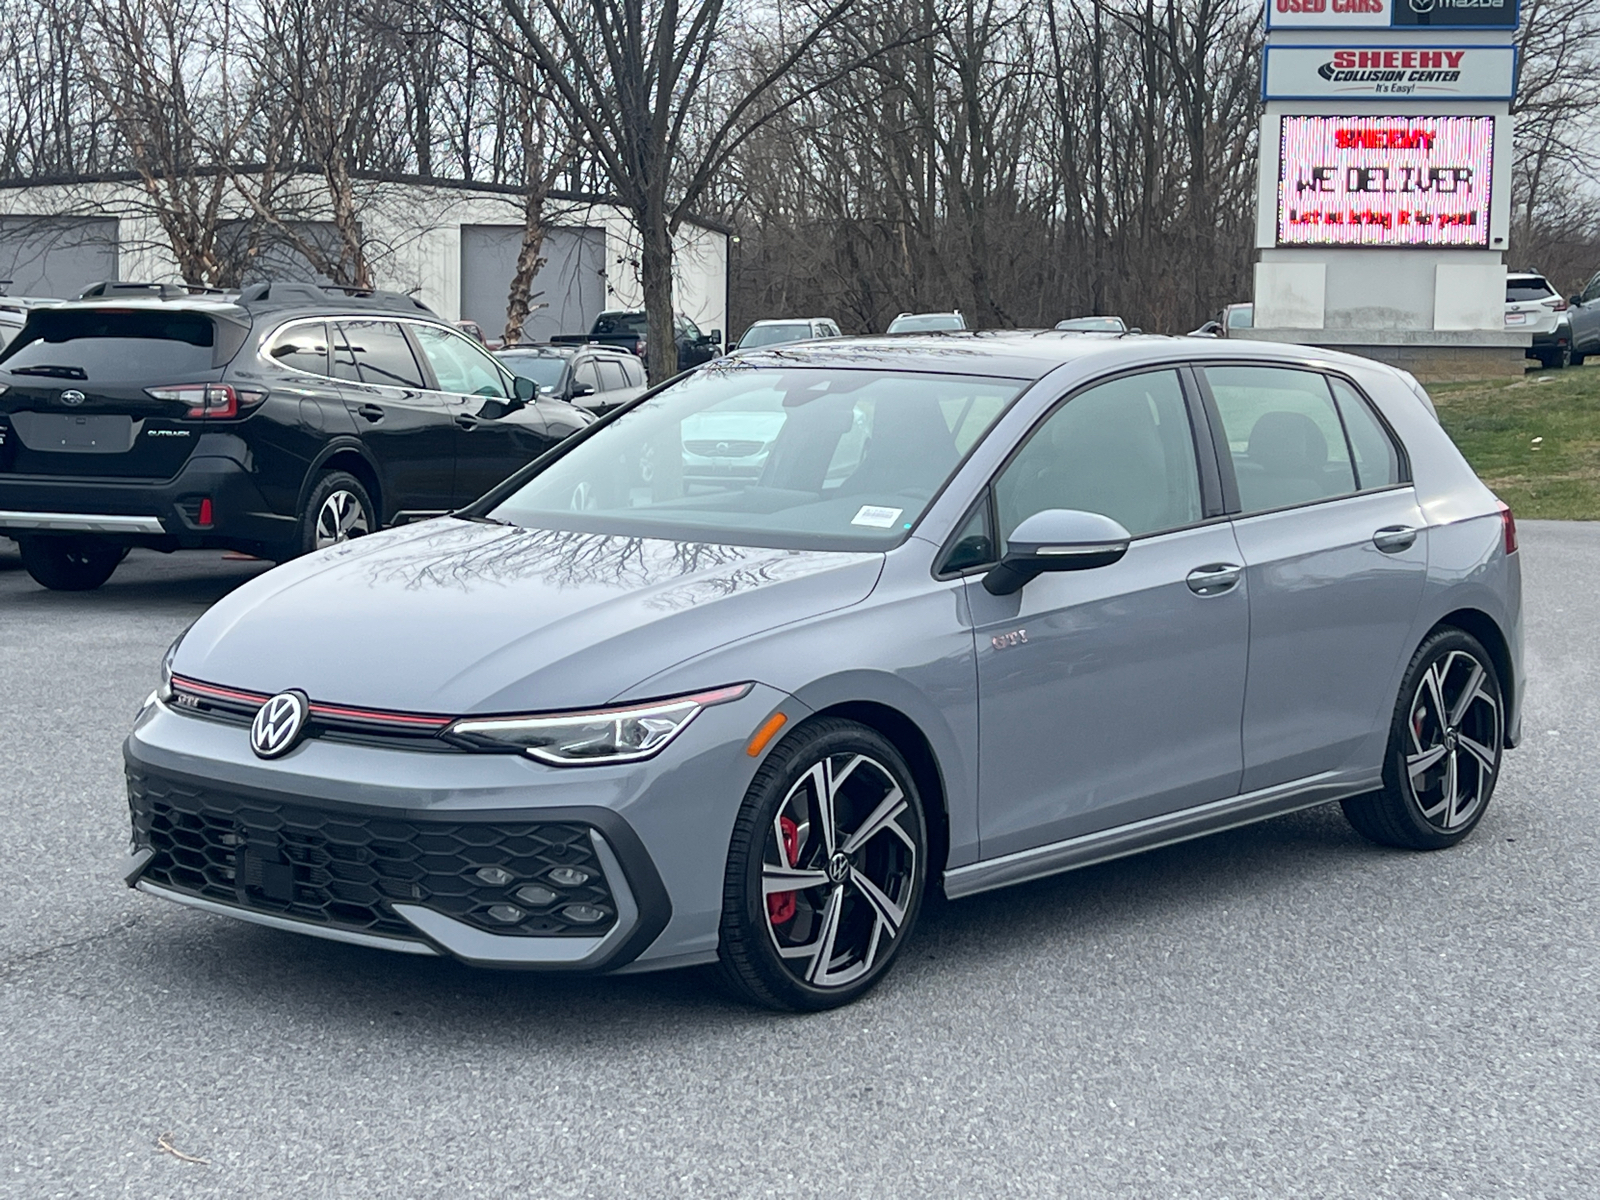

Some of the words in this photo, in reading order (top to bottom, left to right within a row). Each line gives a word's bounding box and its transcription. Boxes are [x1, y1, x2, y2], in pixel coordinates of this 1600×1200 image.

[1277, 0, 1326, 13] USED
[1332, 0, 1384, 13] CARS
[1333, 51, 1465, 69] SHEEHY
[1333, 70, 1406, 82] COLLISION
[1408, 70, 1461, 82] CENTER
[1376, 84, 1389, 93] It's
[1391, 84, 1416, 95] Easy!
[1297, 166, 1338, 192] WE
[1347, 166, 1473, 193] DELIVER
[992, 629, 1028, 650] GTI
